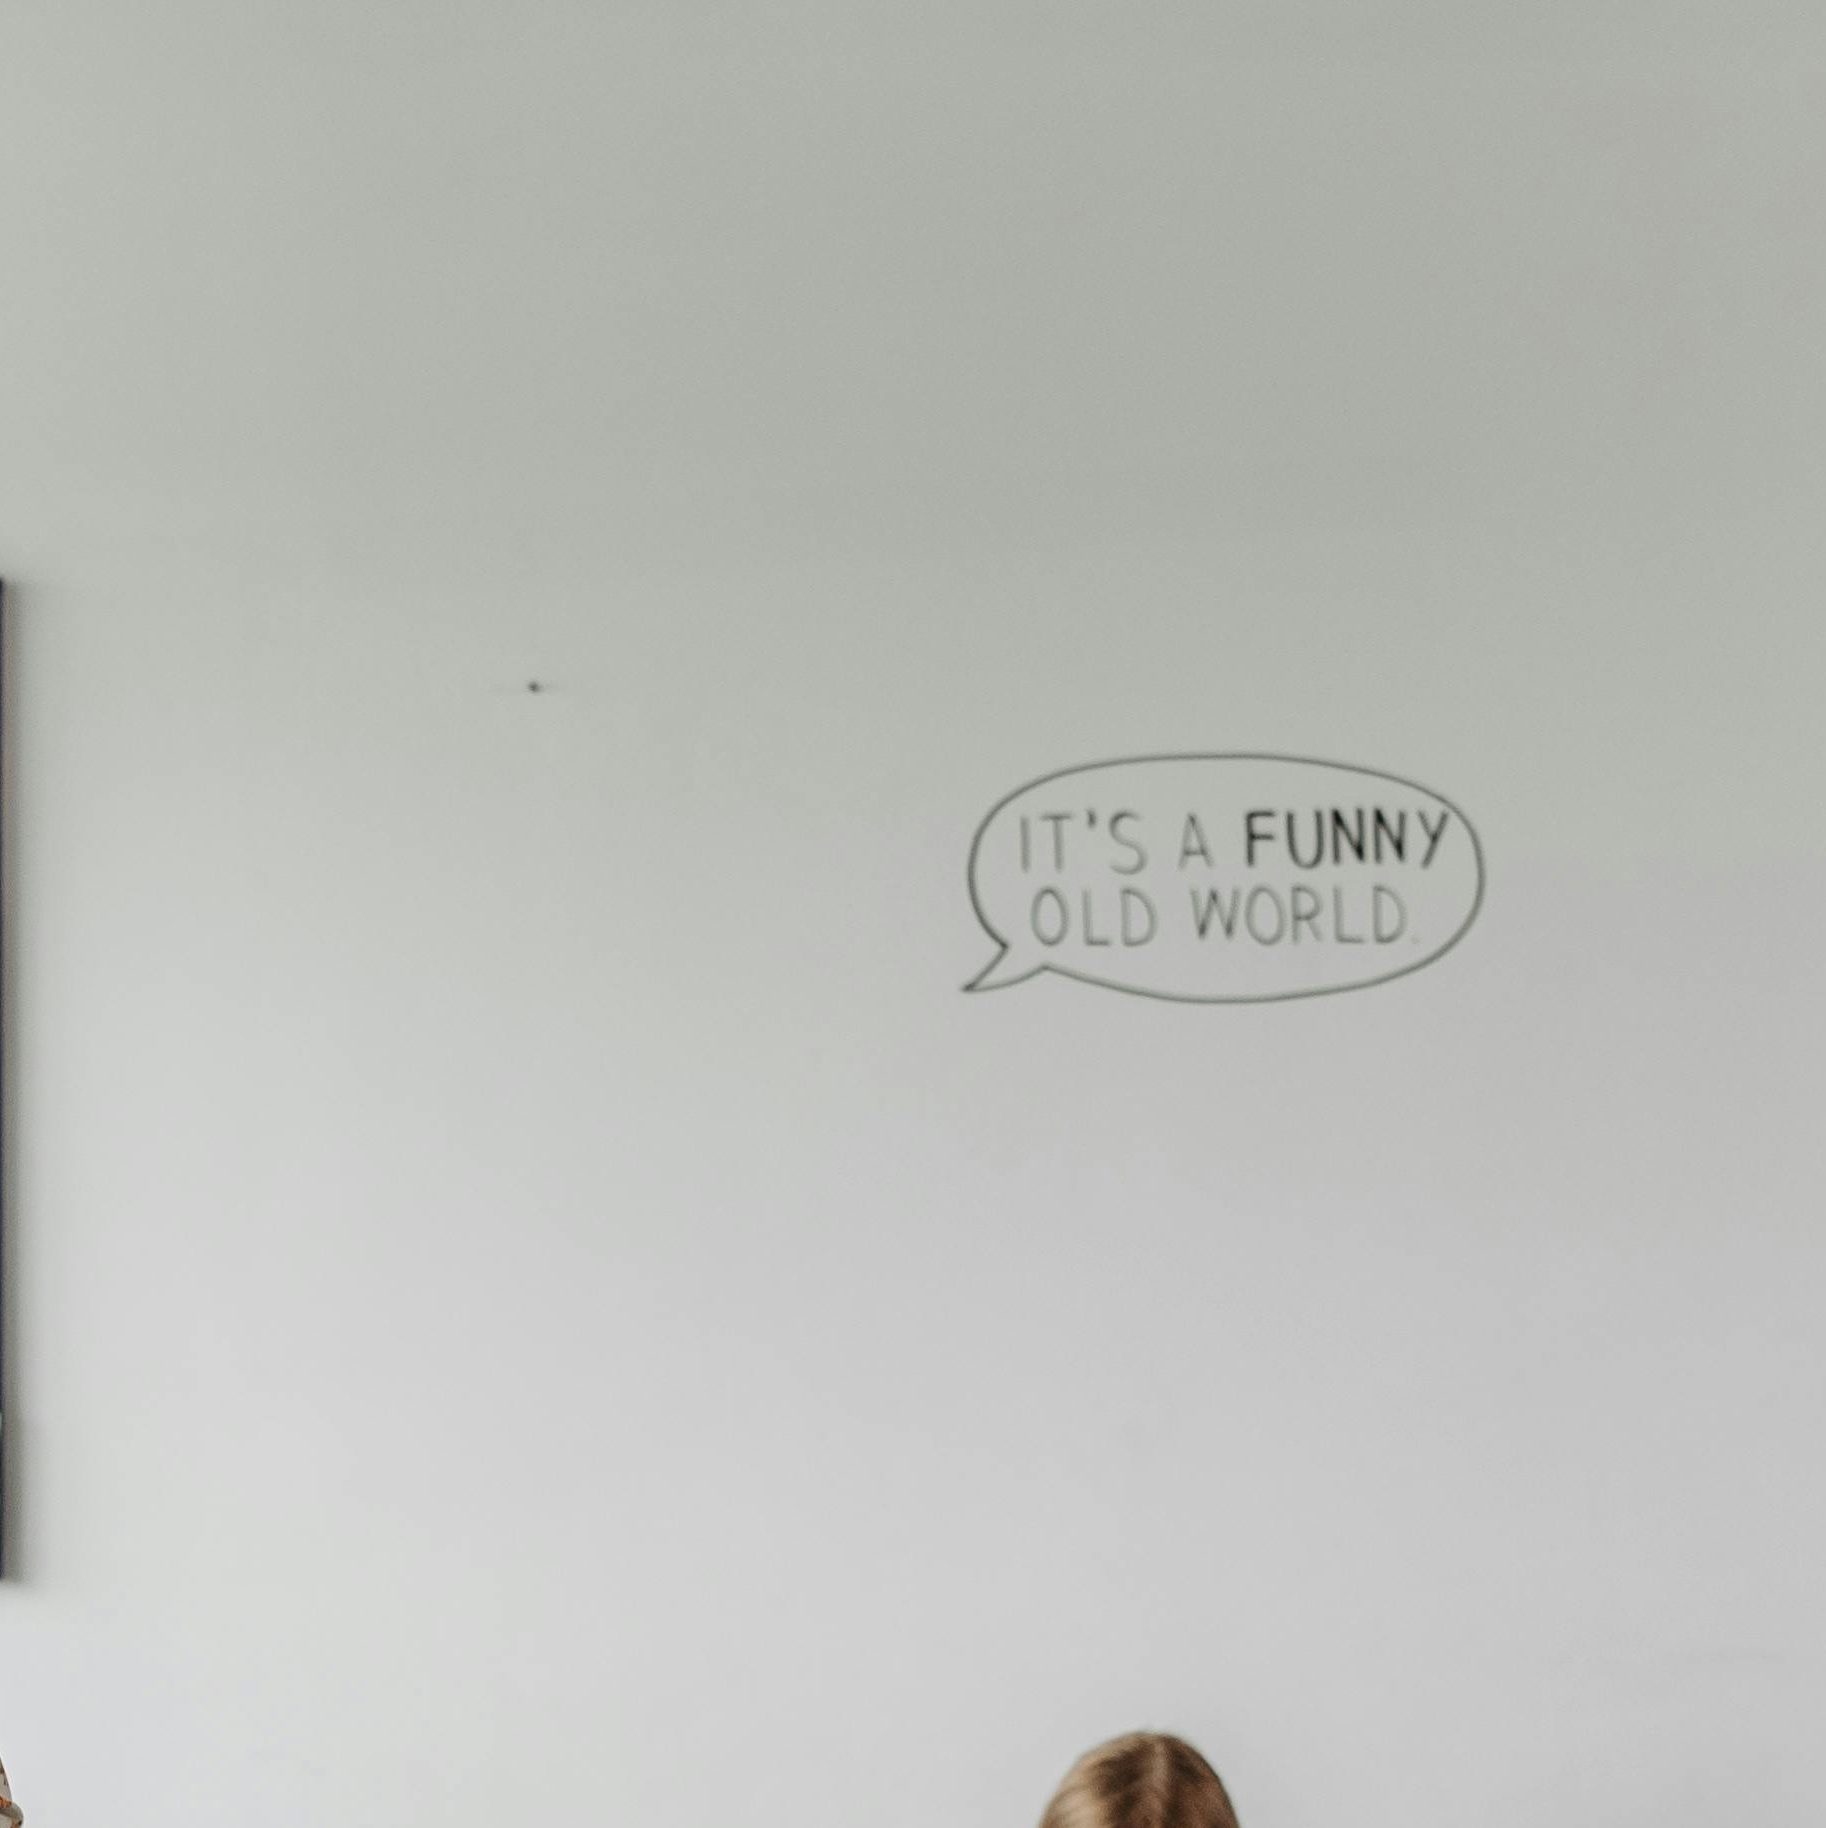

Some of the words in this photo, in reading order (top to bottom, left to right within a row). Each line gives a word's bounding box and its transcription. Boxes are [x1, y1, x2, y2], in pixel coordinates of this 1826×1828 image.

[1019, 808, 1149, 875] IT'S
[1177, 812, 1215, 870] A
[1243, 807, 1450, 869] FUNNY
[1029, 886, 1158, 947] OLD
